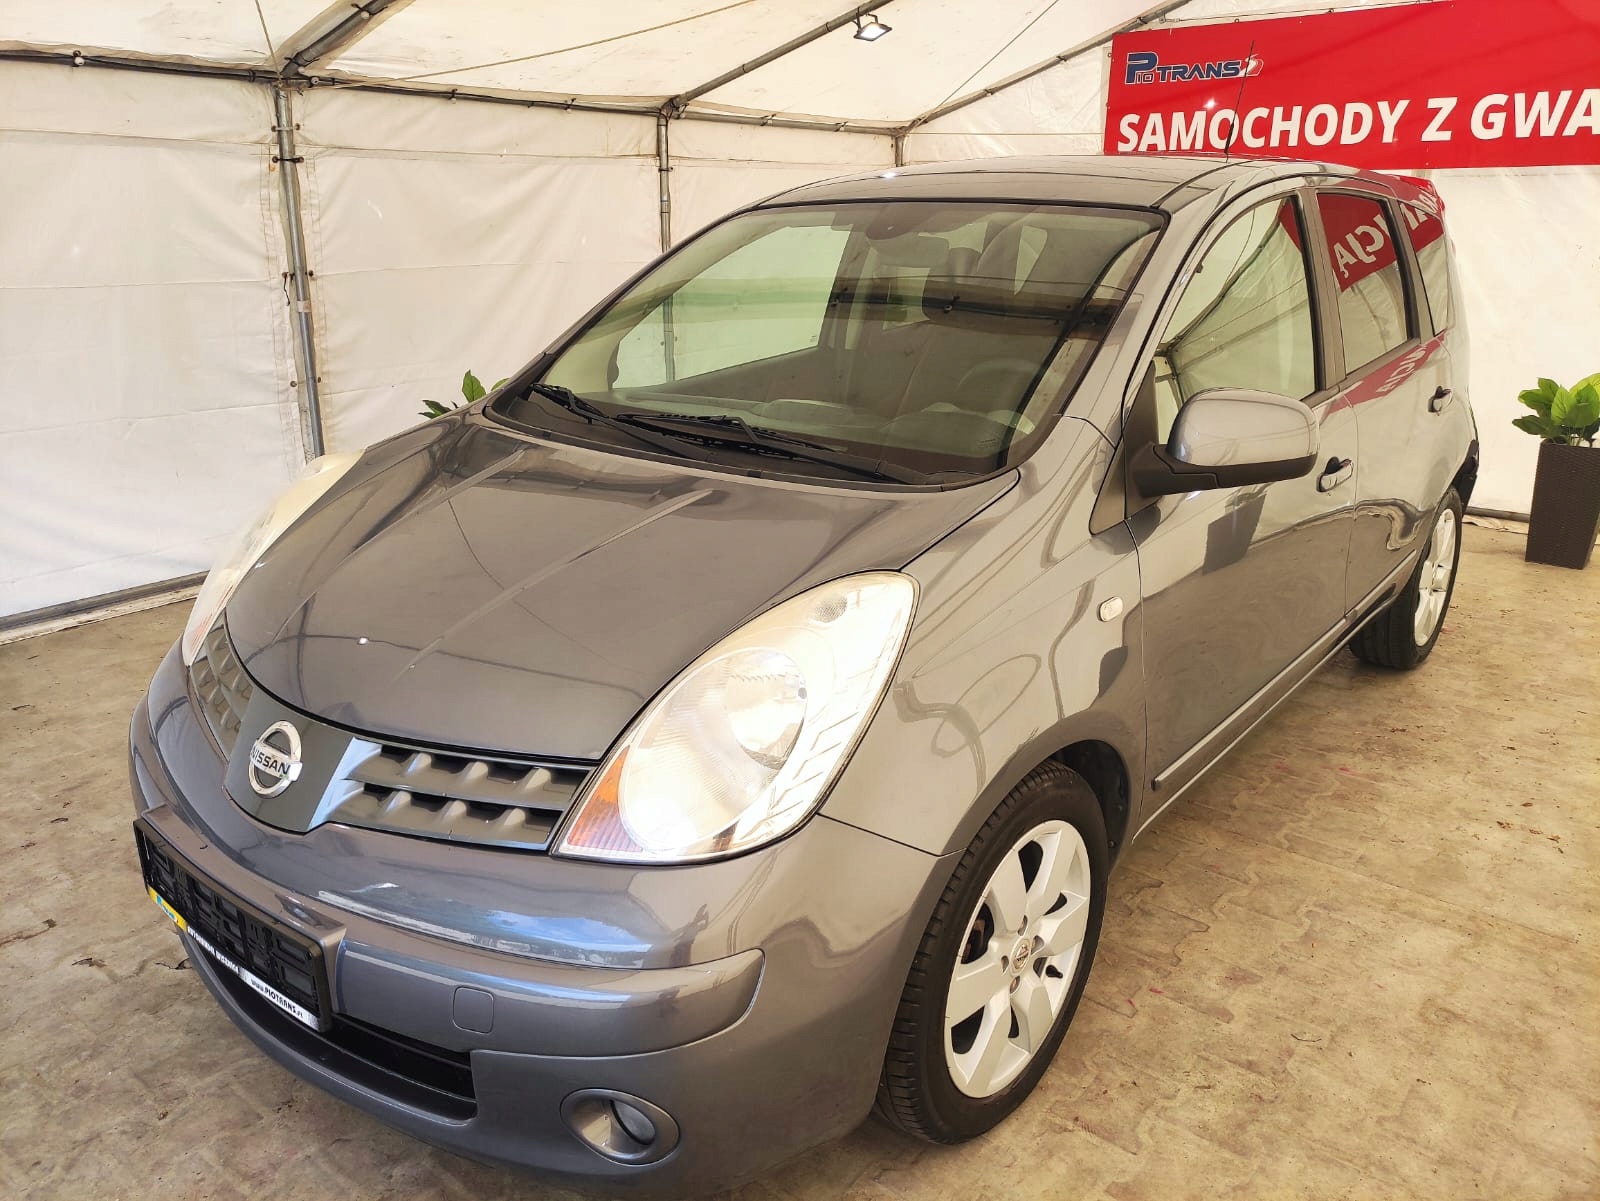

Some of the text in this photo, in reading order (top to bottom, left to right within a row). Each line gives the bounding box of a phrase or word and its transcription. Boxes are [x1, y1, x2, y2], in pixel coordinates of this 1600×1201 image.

[1117, 99, 1411, 152] SAMOCHODY
[1421, 96, 1458, 142] Z
[250, 746, 291, 775] NISSAN
